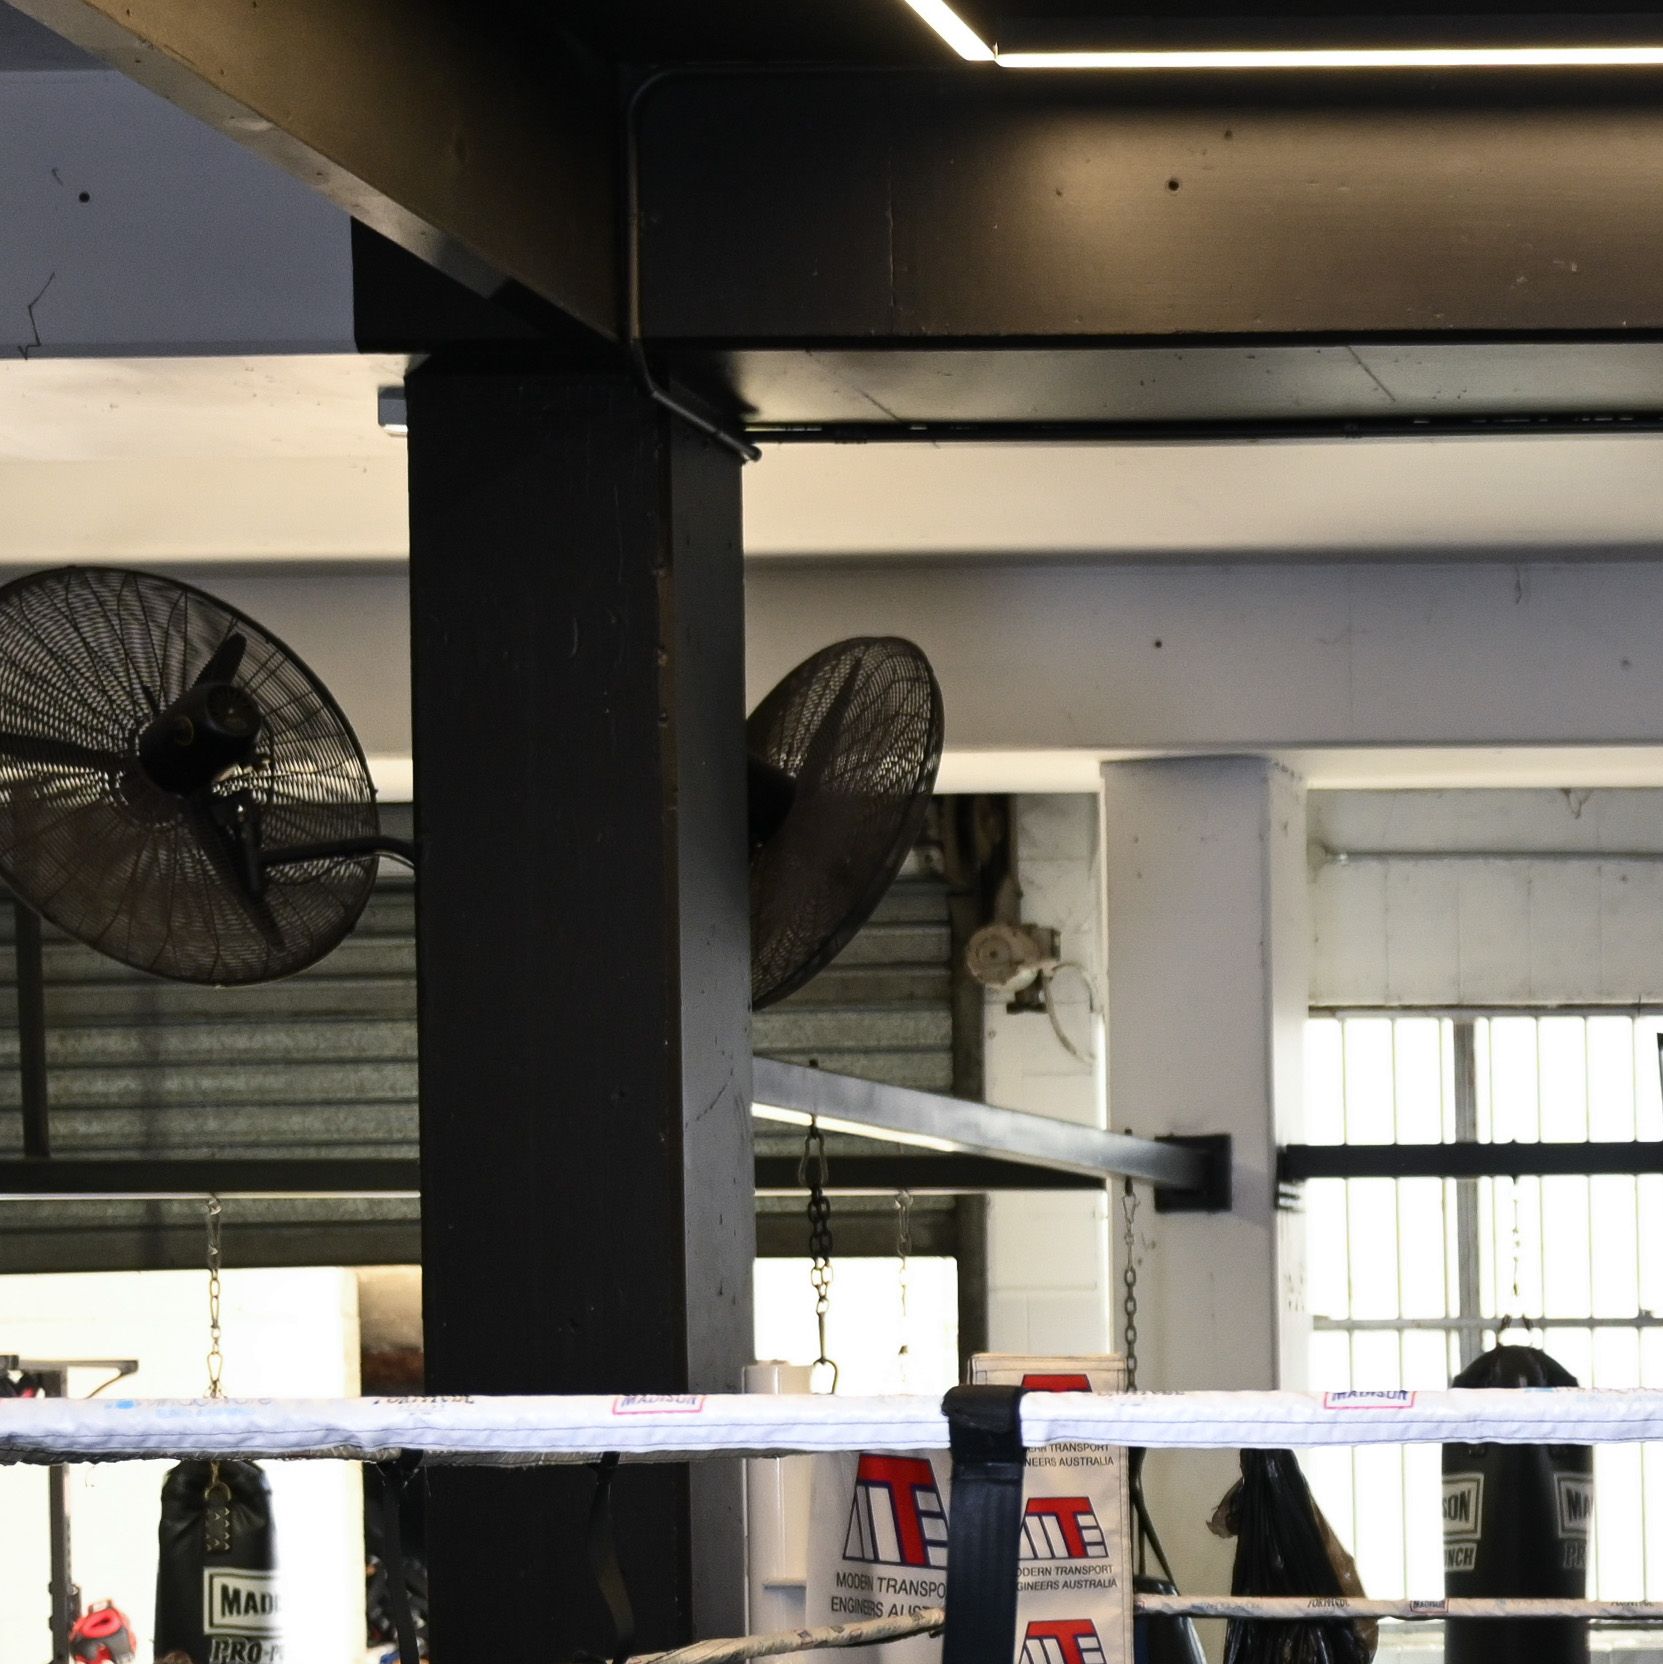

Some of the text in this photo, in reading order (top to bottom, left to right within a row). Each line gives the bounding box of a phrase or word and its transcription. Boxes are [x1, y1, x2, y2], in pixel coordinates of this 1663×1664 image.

[1028, 1443, 1110, 1453] ERN TRANSPORT
[1025, 1456, 1114, 1470] NEERS AUSTRALIA
[1018, 1564, 1114, 1577] ODERN TRANSPORT
[836, 1573, 946, 1598] MODERN TRANSPO
[1018, 1578, 1118, 1592] GINEERS AUSTRALIA
